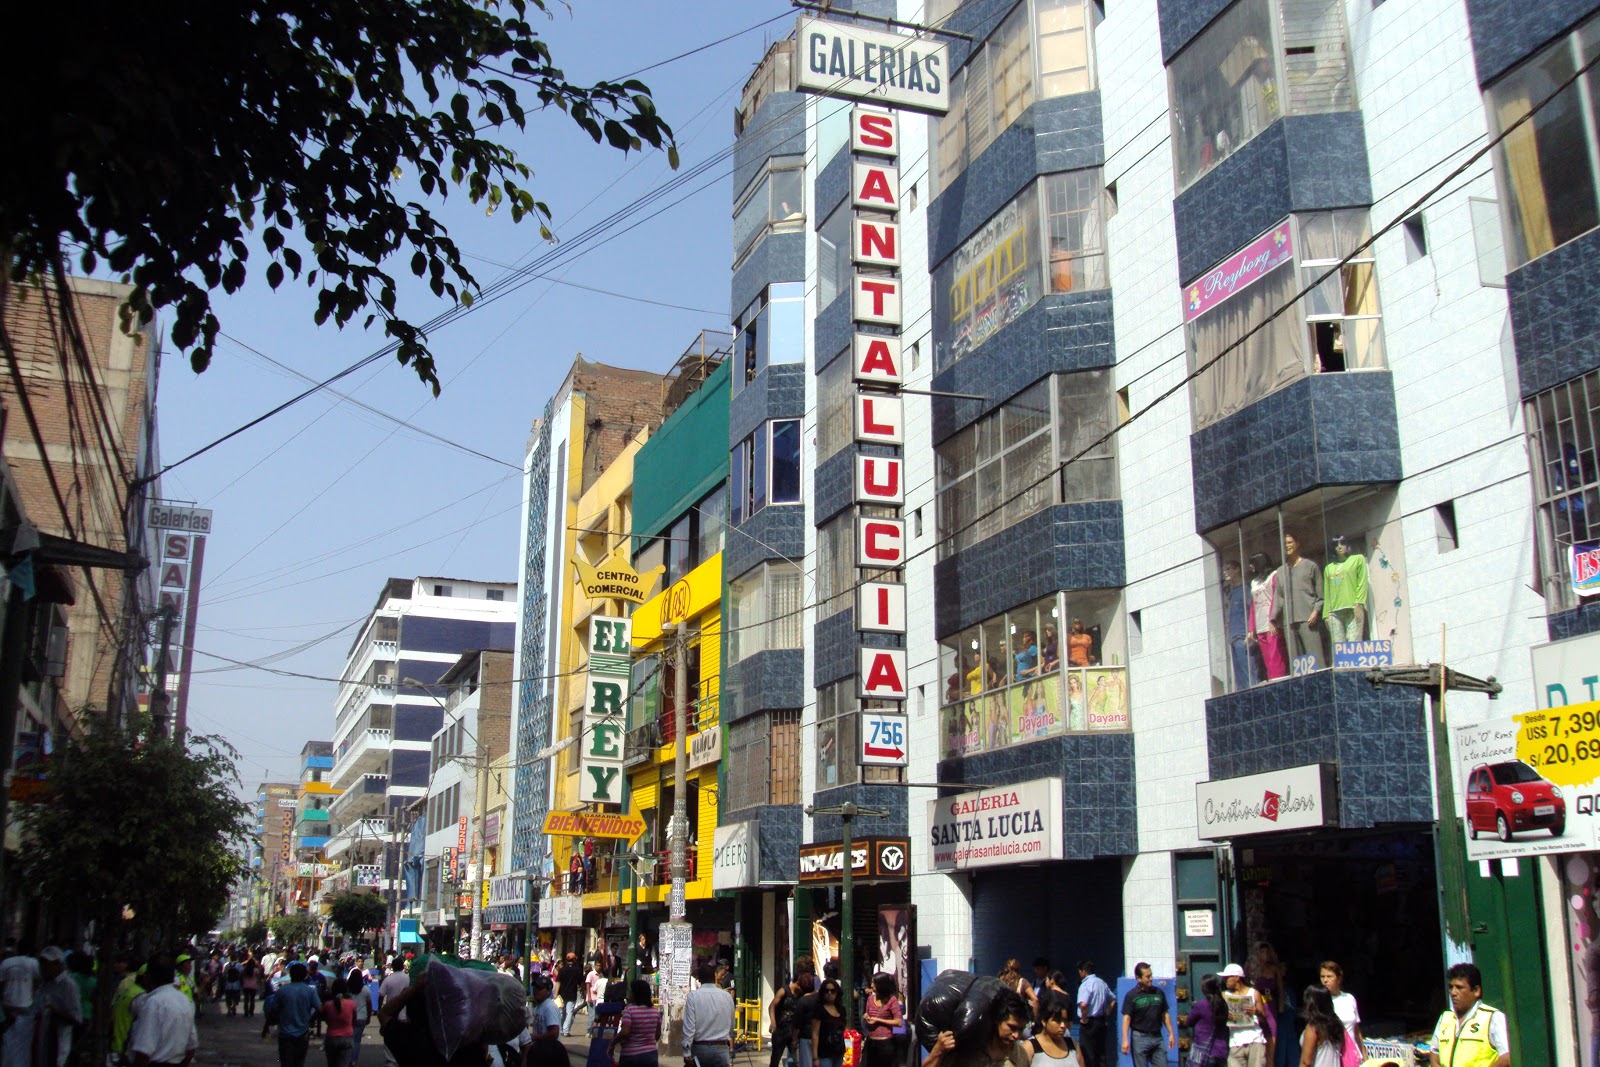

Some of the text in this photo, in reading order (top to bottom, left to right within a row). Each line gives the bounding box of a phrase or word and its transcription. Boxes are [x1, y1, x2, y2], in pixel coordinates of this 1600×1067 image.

[809, 32, 941, 95] GALERIAS
[150, 505, 209, 531] Galerías
[597, 571, 639, 584] CENTRO
[588, 585, 645, 601] COMERCIAL
[593, 619, 630, 654] EL
[1335, 640, 1390, 654] PIJAMAS
[1293, 655, 1316, 676] 202
[1358, 655, 1389, 668] 202
[1018, 711, 1055, 734] Dayana
[1089, 712, 1127, 724] Dayana
[1525, 713, 1546, 724] Desde
[1526, 710, 1600, 741] US$ 7,39
[589, 681, 623, 799] REY
[869, 720, 904, 746] 756
[1494, 730, 1513, 740] Kms
[950, 791, 1020, 816] GALERIA
[1204, 798, 1262, 825] Cristina
[548, 815, 643, 835] BIENVENIDOS
[931, 809, 1044, 846] SANTA LUCIA
[714, 842, 748, 868] PIEERS
[935, 840, 1041, 864] www.galeriasantalucia.com
[442, 848, 450, 883] POLOS
